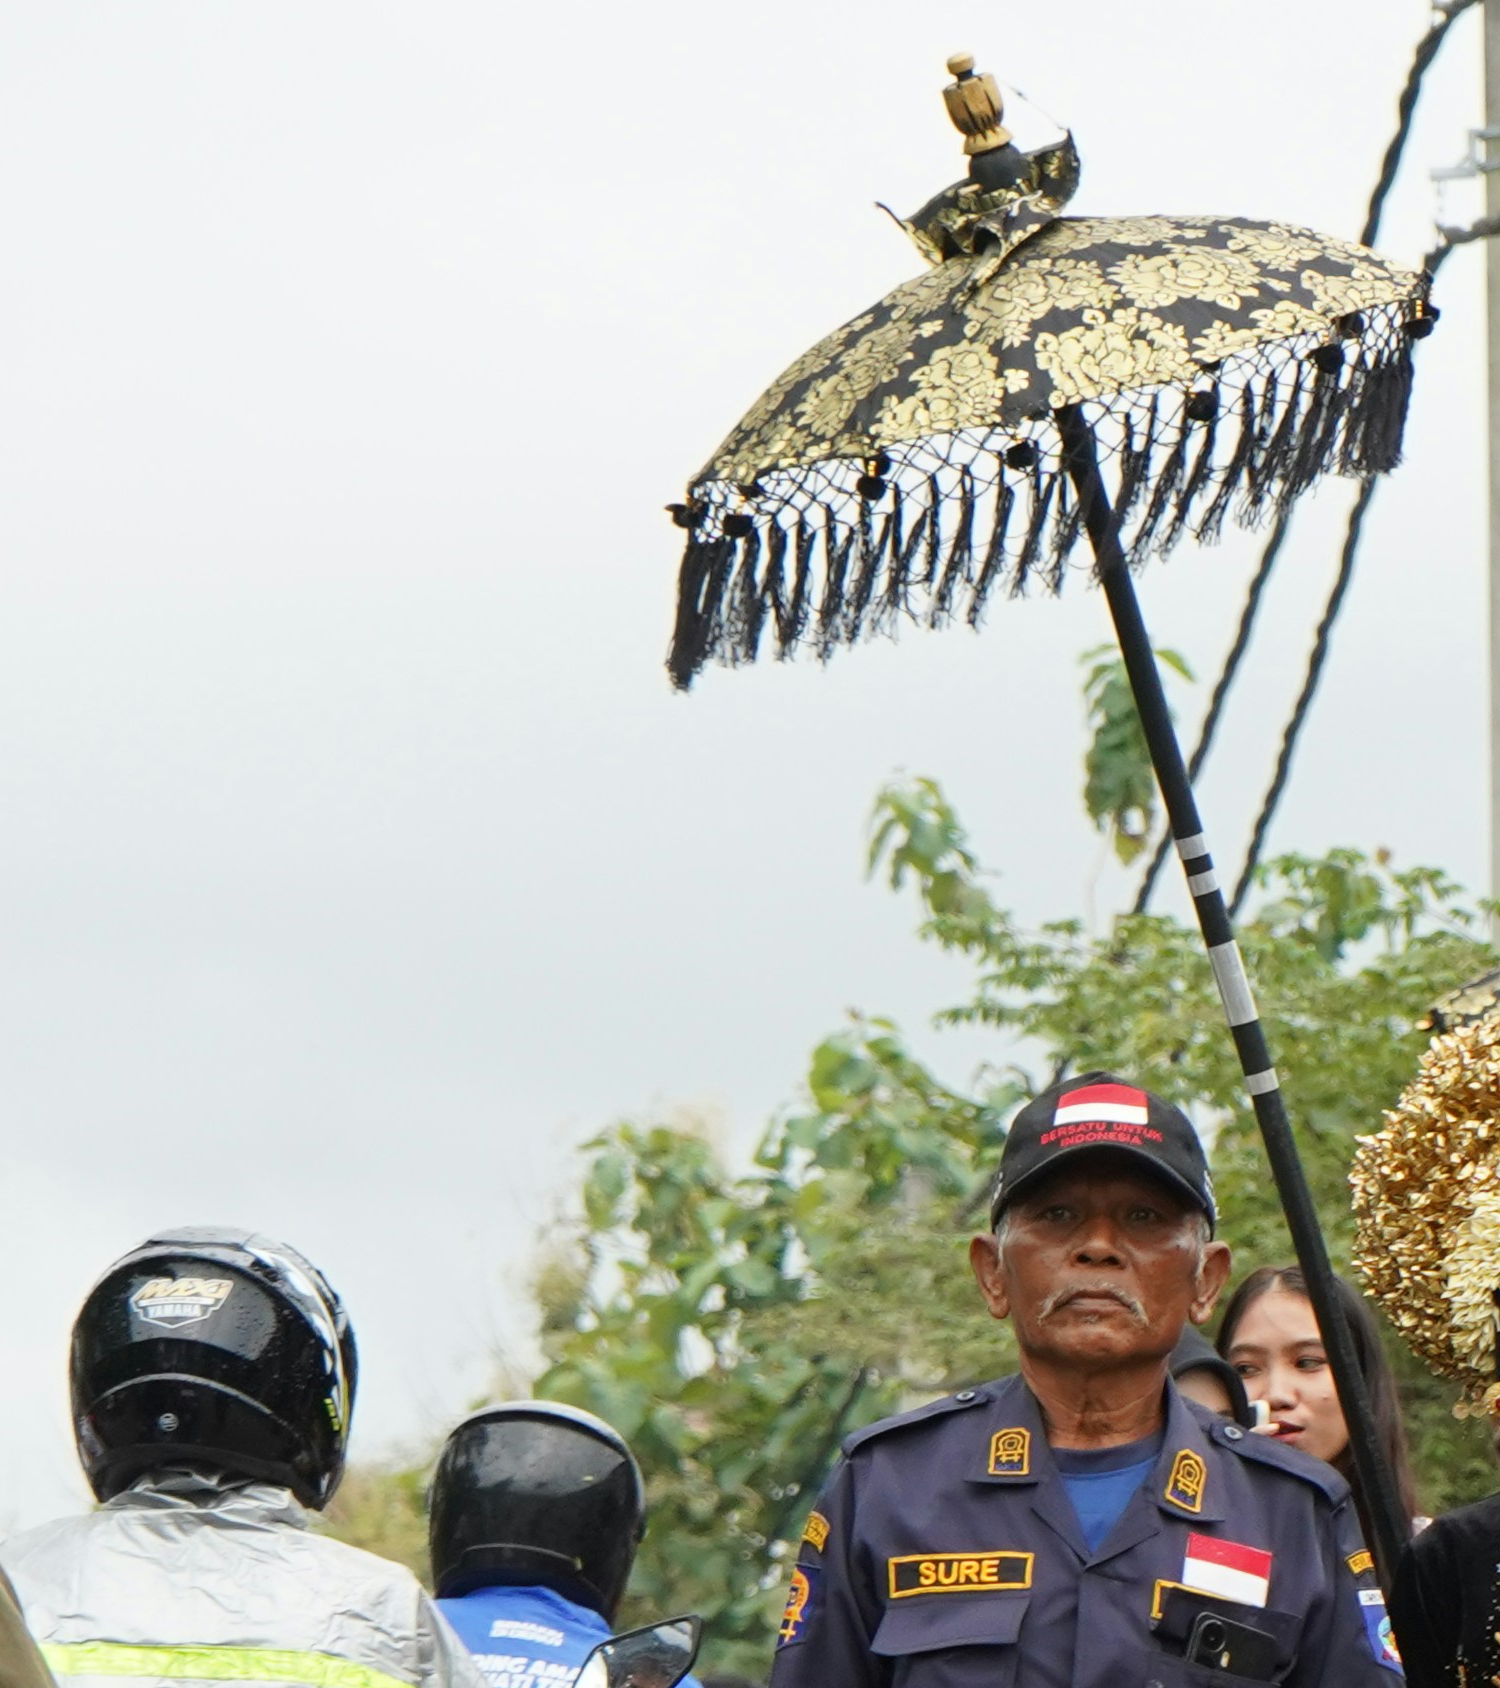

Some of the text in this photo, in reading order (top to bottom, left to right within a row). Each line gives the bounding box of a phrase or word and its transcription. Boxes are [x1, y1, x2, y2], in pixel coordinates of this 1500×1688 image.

[1040, 1122, 1164, 1145] BERSATU UNTUK
[1059, 1131, 1143, 1148] INDONESIA
[918, 1559, 1001, 1586] SURE
